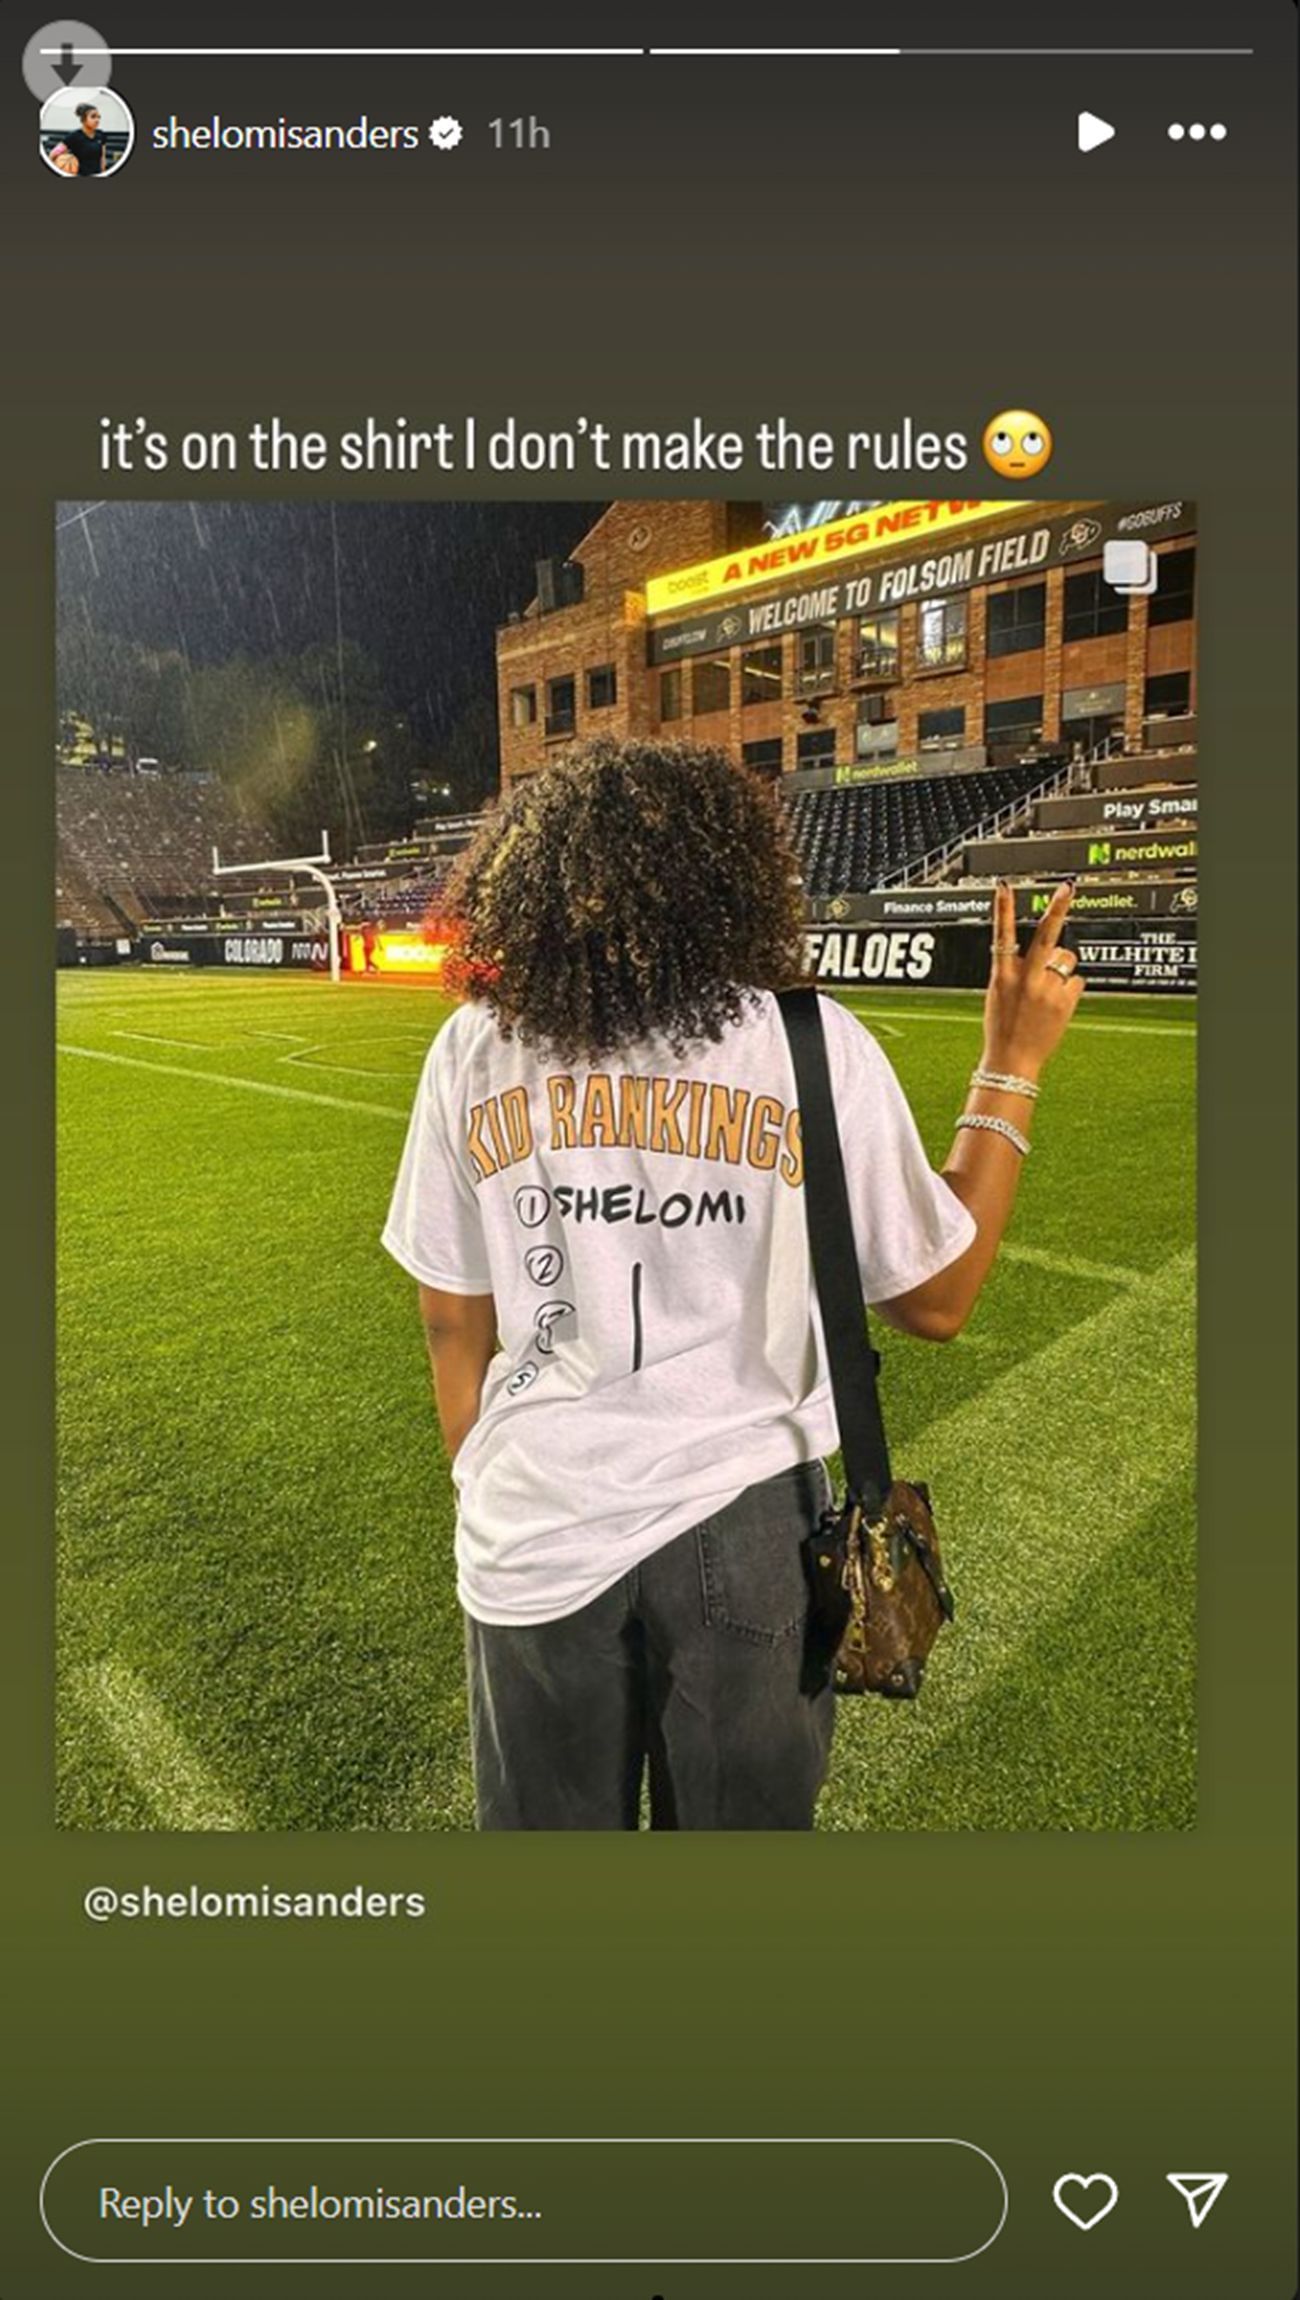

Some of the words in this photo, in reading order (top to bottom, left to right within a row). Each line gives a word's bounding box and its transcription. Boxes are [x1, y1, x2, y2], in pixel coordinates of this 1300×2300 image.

[723, 562, 742, 583] A
[748, 537, 819, 576] NEW
[825, 521, 870, 553] 5G
[749, 583, 839, 635] WELCOME
[845, 577, 872, 611] TO
[879, 546, 977, 602] FOLSOM
[977, 528, 1050, 577] FIELD
[1103, 801, 1145, 820] Play
[883, 901, 934, 914] Finance
[936, 899, 991, 913] Smarter
[224, 938, 283, 964] COLORADO
[1140, 932, 1177, 945] THE
[801, 931, 936, 979] FALOES
[1078, 946, 1185, 963] WILHITE
[1134, 964, 1179, 977] FIRM
[466, 1084, 535, 1186] KID
[546, 1073, 806, 1189] RANKINGS
[552, 1183, 747, 1229] SHELOMI
